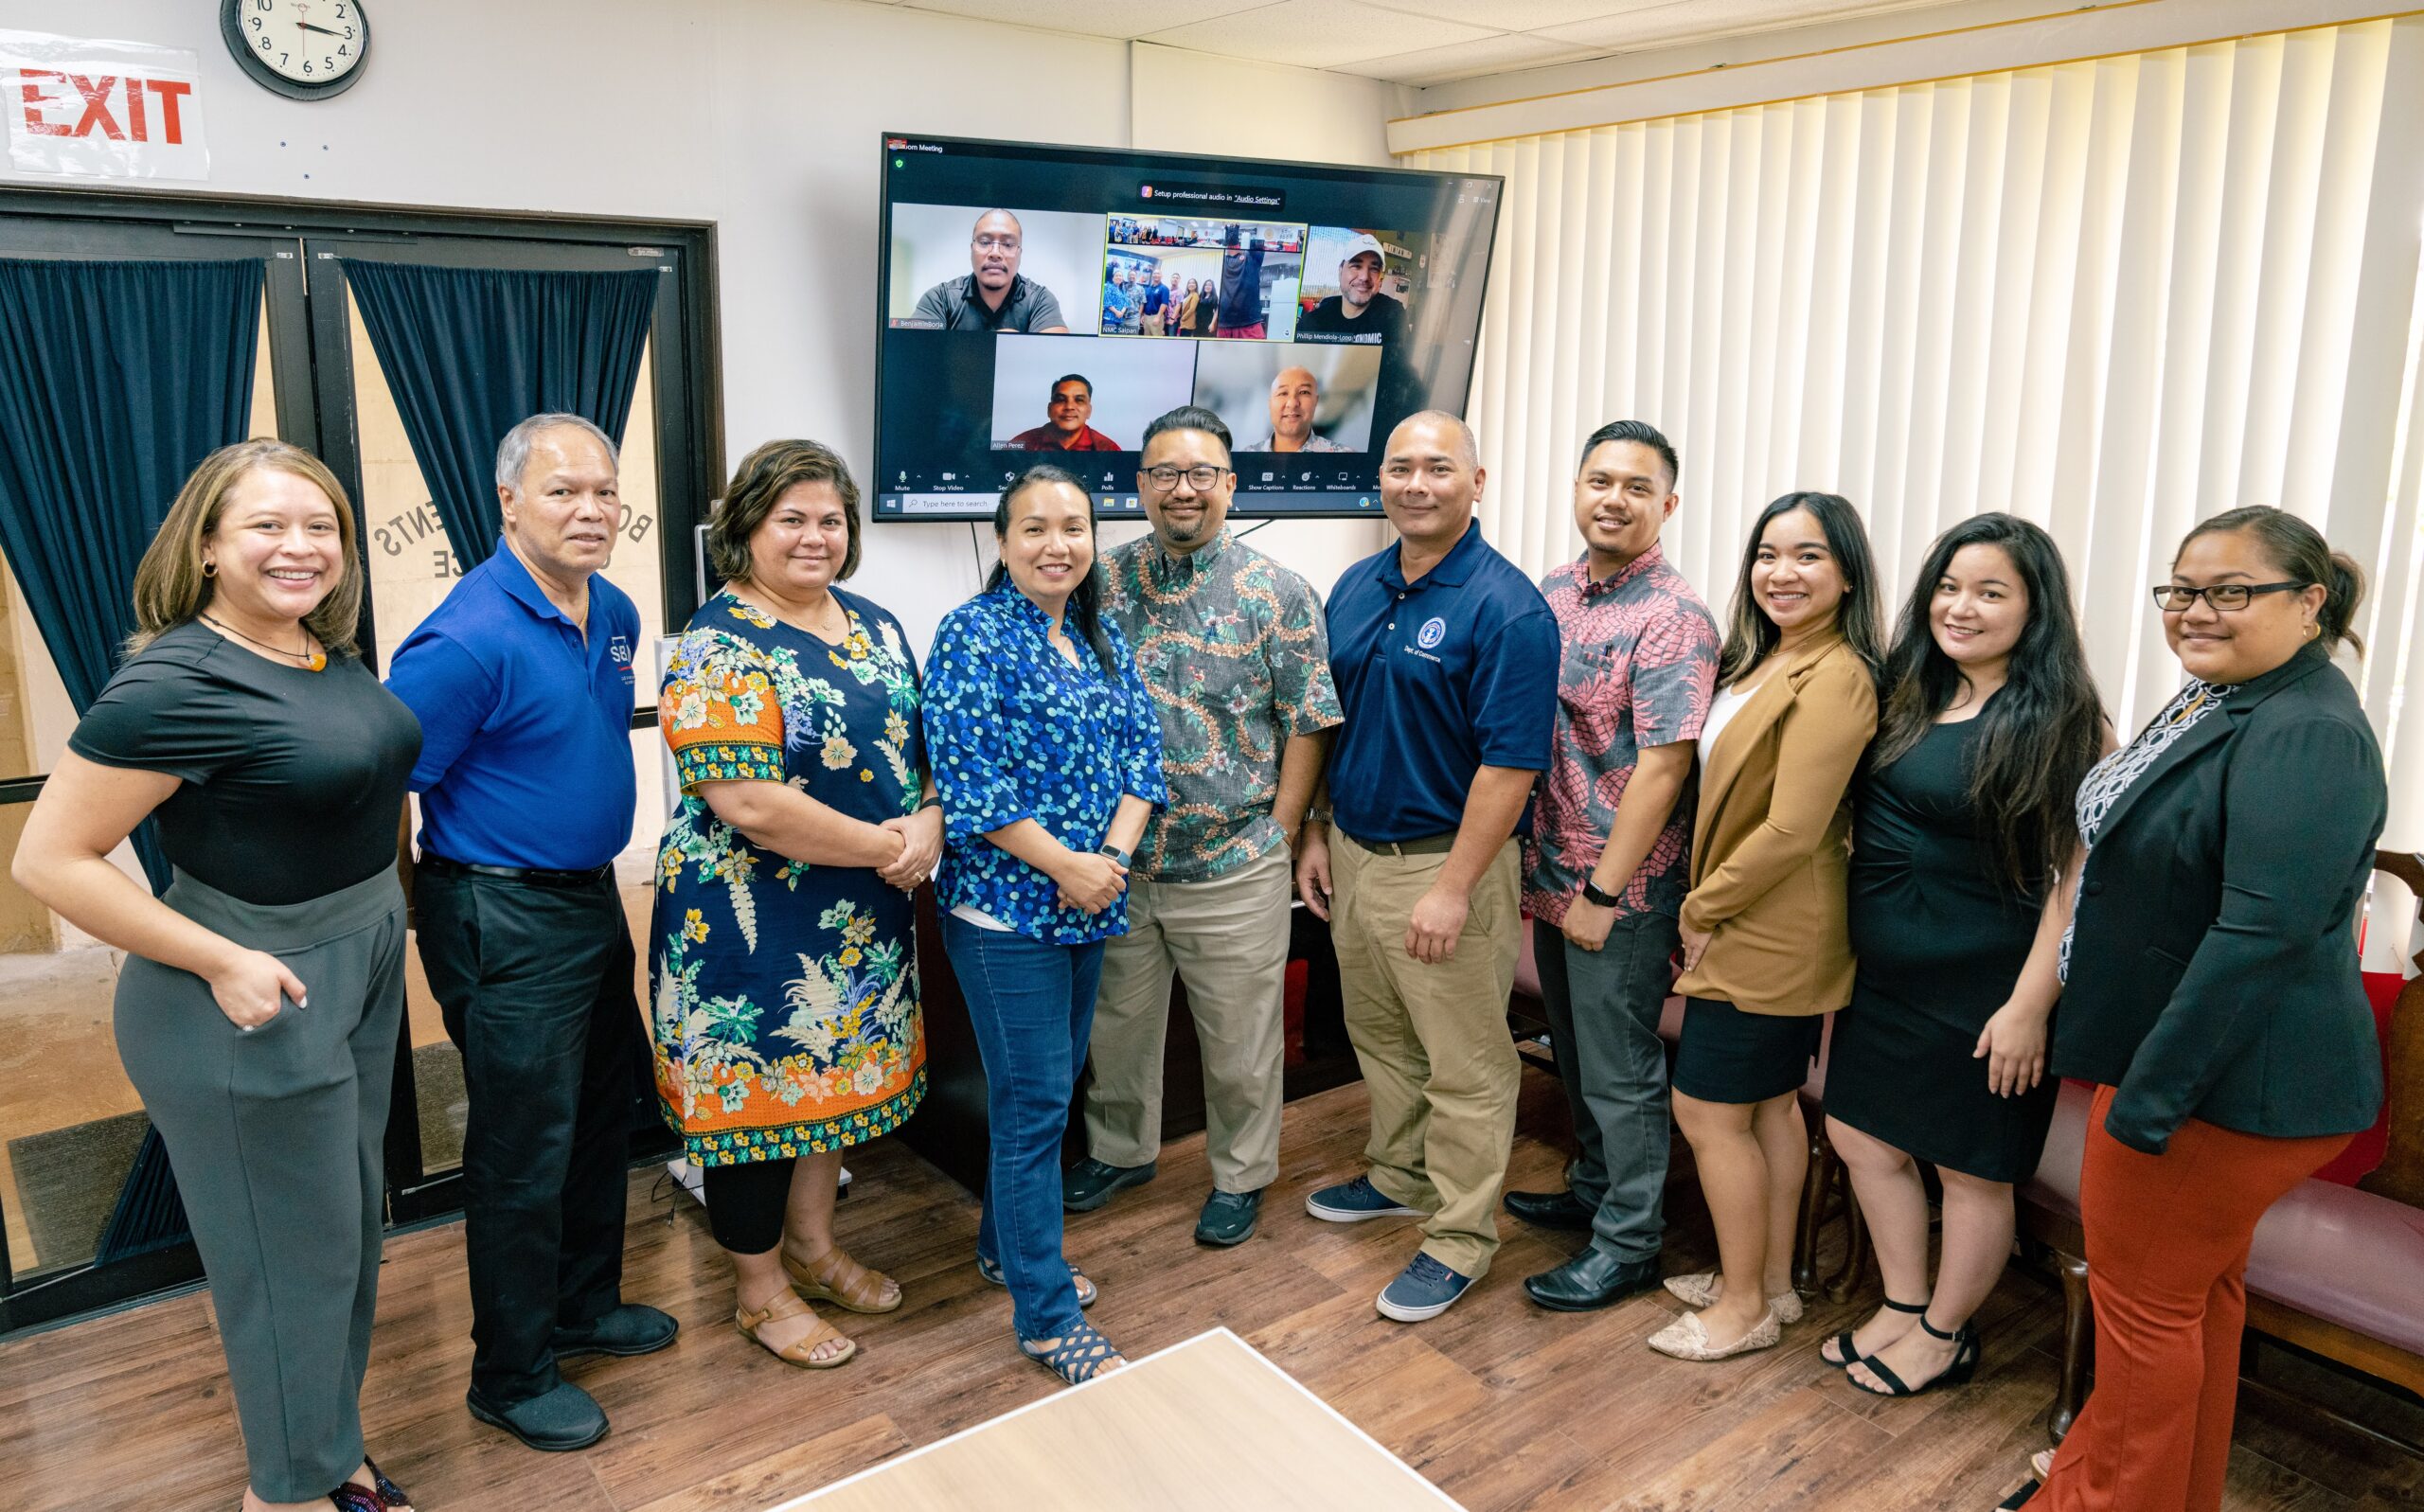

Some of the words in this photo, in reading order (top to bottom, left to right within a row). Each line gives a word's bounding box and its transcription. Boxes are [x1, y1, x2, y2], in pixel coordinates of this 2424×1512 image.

[258, 0, 272, 11] 10
[335, 4, 346, 18] 2
[252, 17, 262, 31] 9
[344, 27, 353, 40] 3
[261, 36, 272, 50] 8
[337, 44, 348, 57] 4
[280, 53, 290, 65] 7
[325, 57, 334, 70] 5
[303, 61, 312, 73] 6
[19, 68, 191, 145] EXIT
[918, 144, 943, 153] Meeting
[1154, 189, 1171, 199] Setup
[1172, 191, 1208, 200] professional
[1208, 193, 1226, 202] audio
[923, 500, 938, 508] Type
